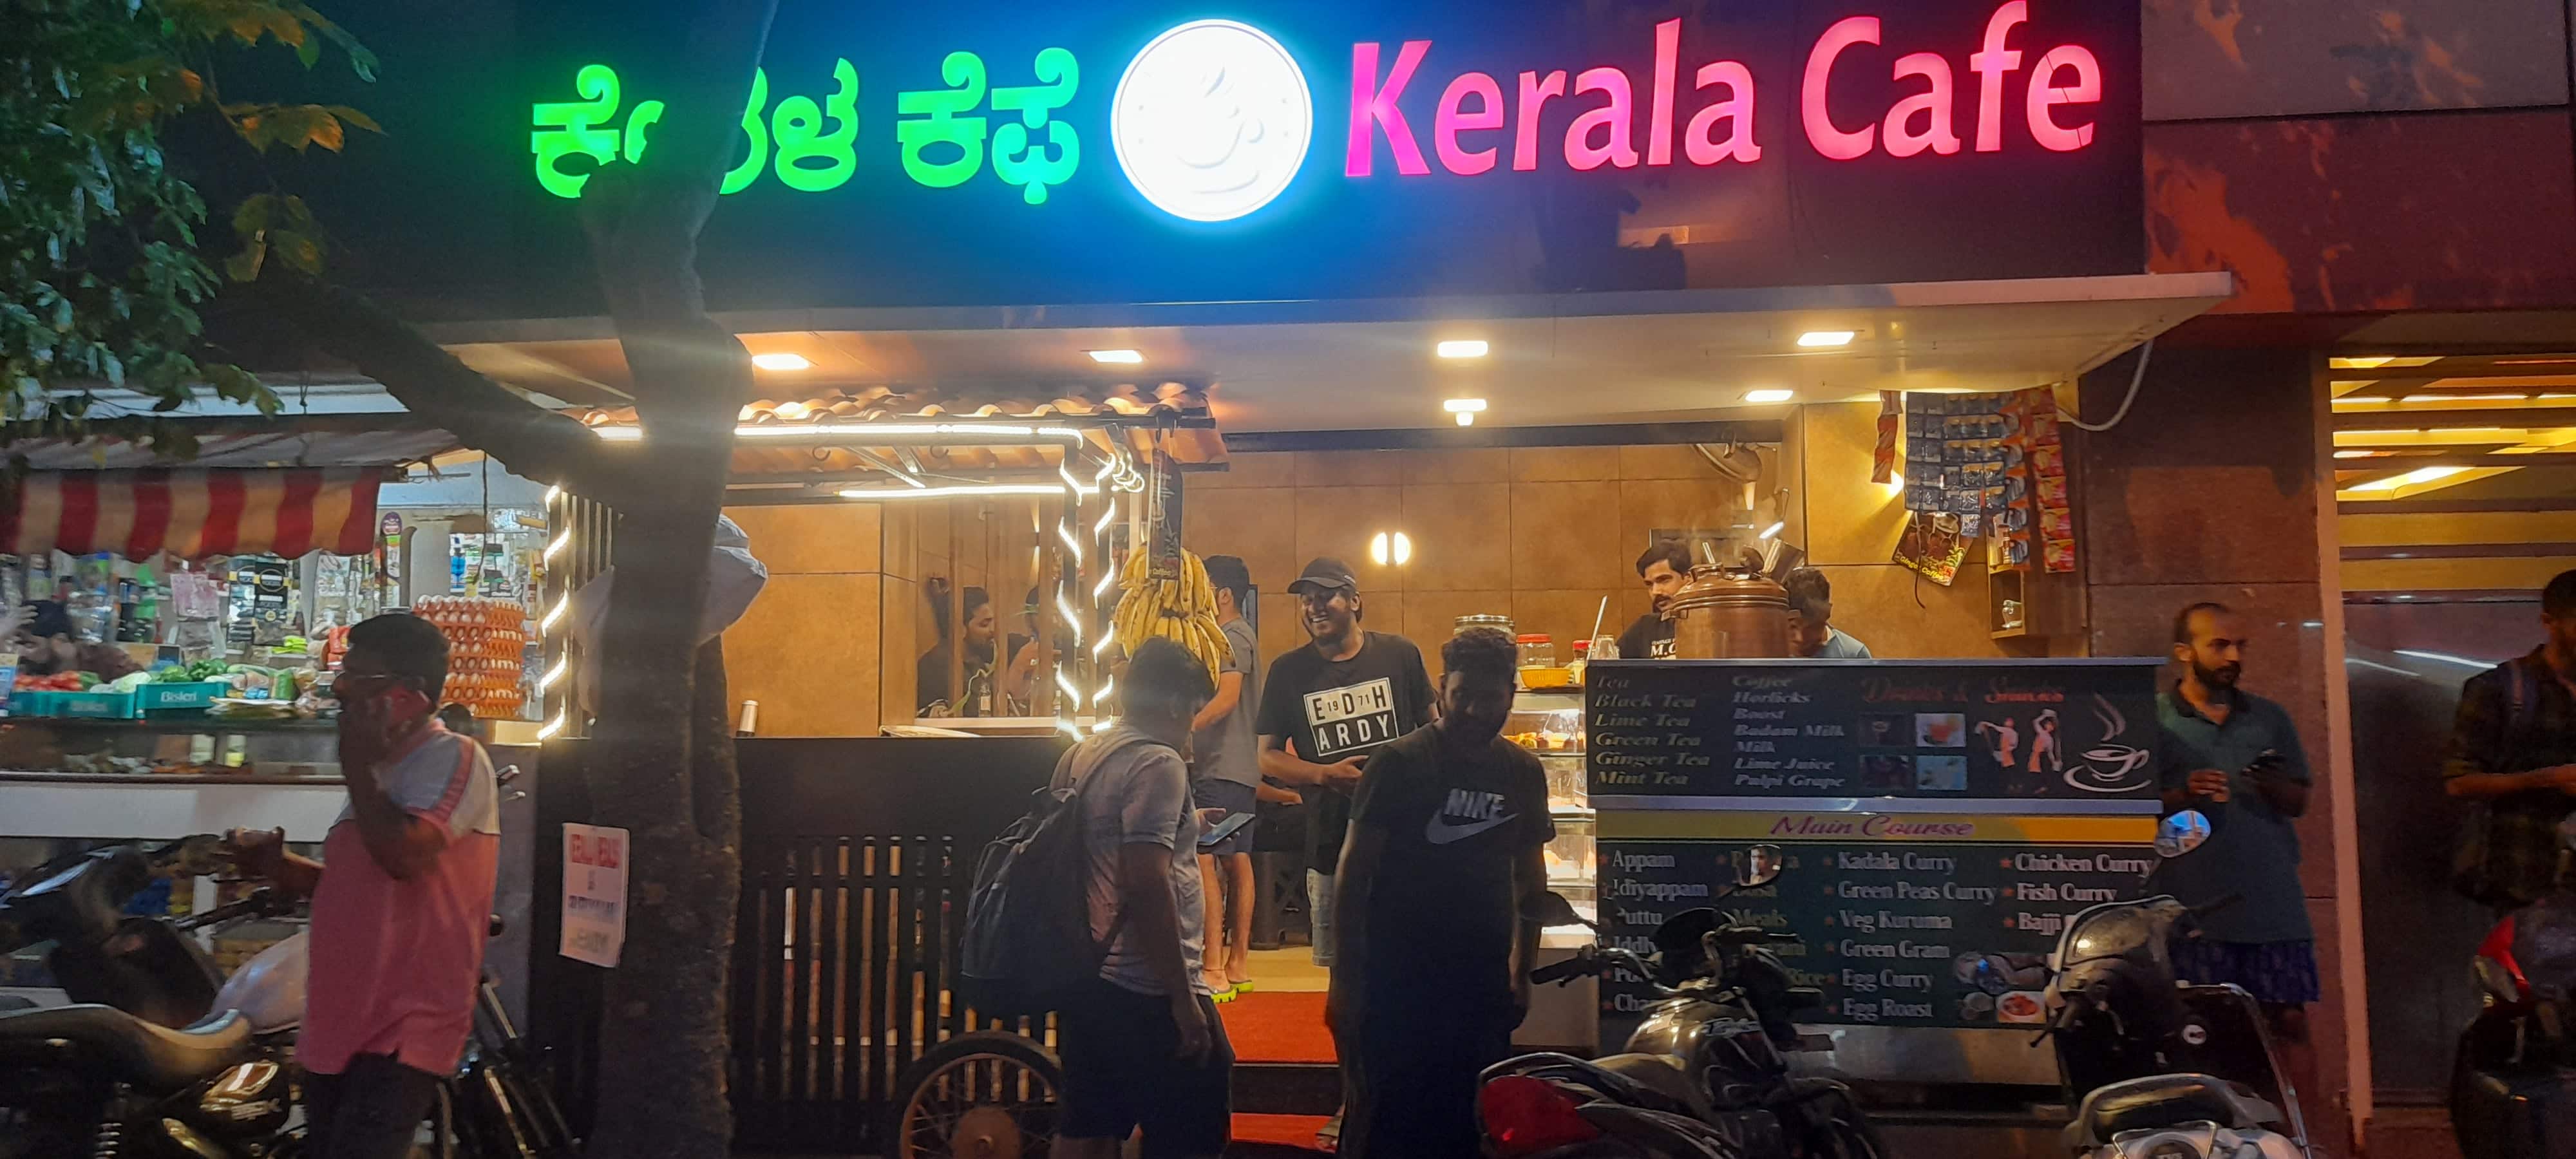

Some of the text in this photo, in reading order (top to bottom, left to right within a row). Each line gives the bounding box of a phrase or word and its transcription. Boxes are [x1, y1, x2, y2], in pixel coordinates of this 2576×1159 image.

[1345, 0, 2102, 177] Kerala Cafe
[897, 47, 1080, 204] ಕೆಫೆ
[1598, 675, 1629, 688] Tea
[1732, 675, 1793, 689] Coffee
[1595, 694, 1697, 708] Black Tea
[1733, 691, 1810, 704] Horlicks
[1595, 713, 1690, 727] Lime Tea
[1734, 708, 1786, 719] Boost
[1318, 713, 1389, 751] ARDY
[1595, 732, 1701, 747] Green Tea
[1734, 724, 1844, 737] Badam Milk
[1735, 740, 1776, 753] Milk
[1595, 751, 1710, 768] Ginger Tea
[1734, 757, 1835, 770] Lime Juice
[1595, 771, 1690, 785] Mint Tea
[1788, 775, 1845, 789] Grape
[1444, 787, 1506, 820] NIKE
[1771, 815, 1975, 836] Main Course
[1612, 849, 1675, 872] Appam
[1838, 851, 1957, 875] Kadala Curry
[2014, 853, 2153, 878] Chicken Curry
[1838, 880, 1996, 905] Green Peas Curry
[2017, 882, 2118, 902] Fish Curry
[1839, 909, 1953, 933] Veg Kuruma
[2018, 912, 2061, 936] Bajji
[1840, 939, 1951, 958] Green Gram
[1842, 968, 1933, 993] Egg Curry
[1843, 998, 1933, 1022] Egg Roast
